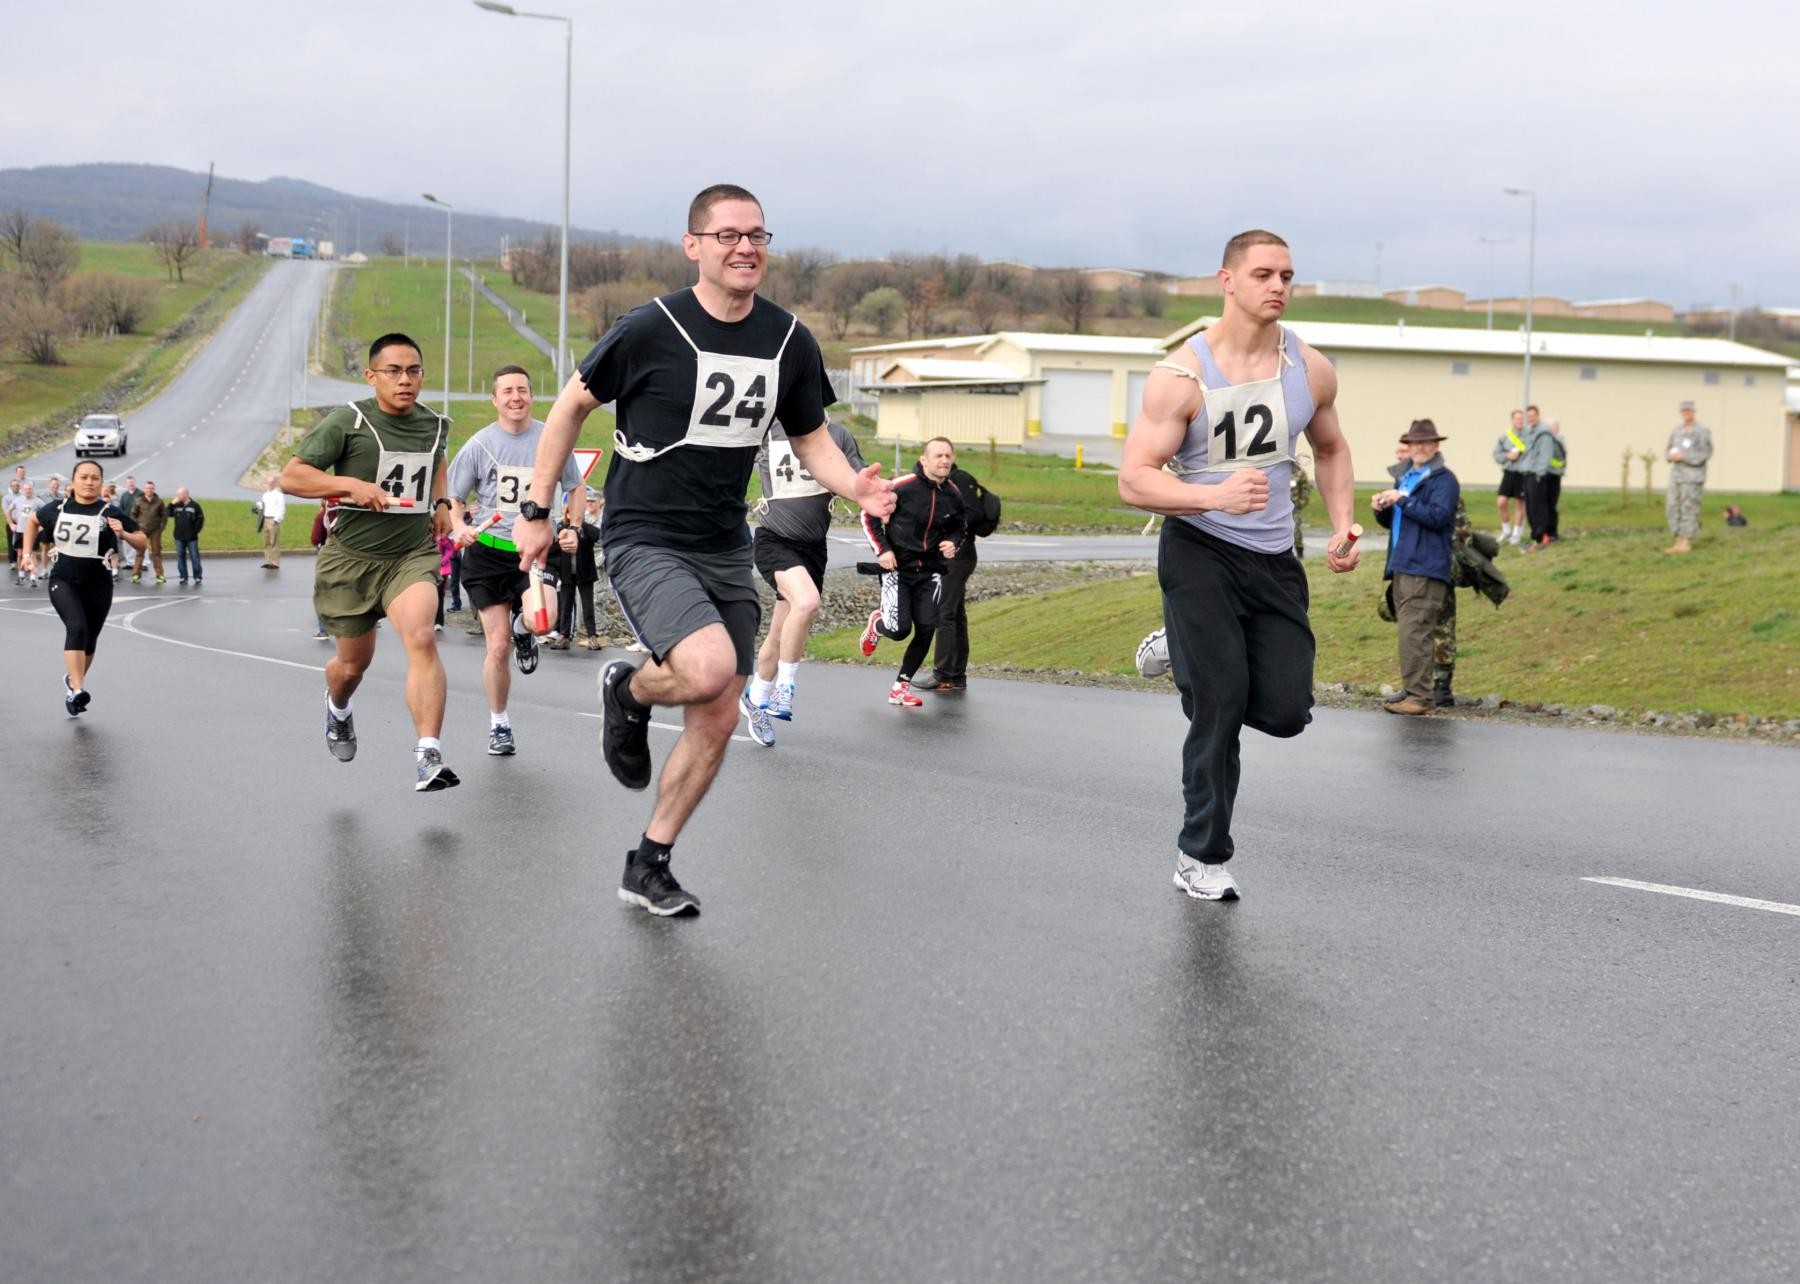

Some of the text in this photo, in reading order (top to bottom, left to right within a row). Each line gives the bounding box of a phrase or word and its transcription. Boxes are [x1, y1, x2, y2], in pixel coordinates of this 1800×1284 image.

[699, 372, 766, 428] 24
[1214, 404, 1277, 460] 12
[380, 464, 427, 501] 41
[500, 476, 531, 503] 3
[57, 521, 90, 545] 52
